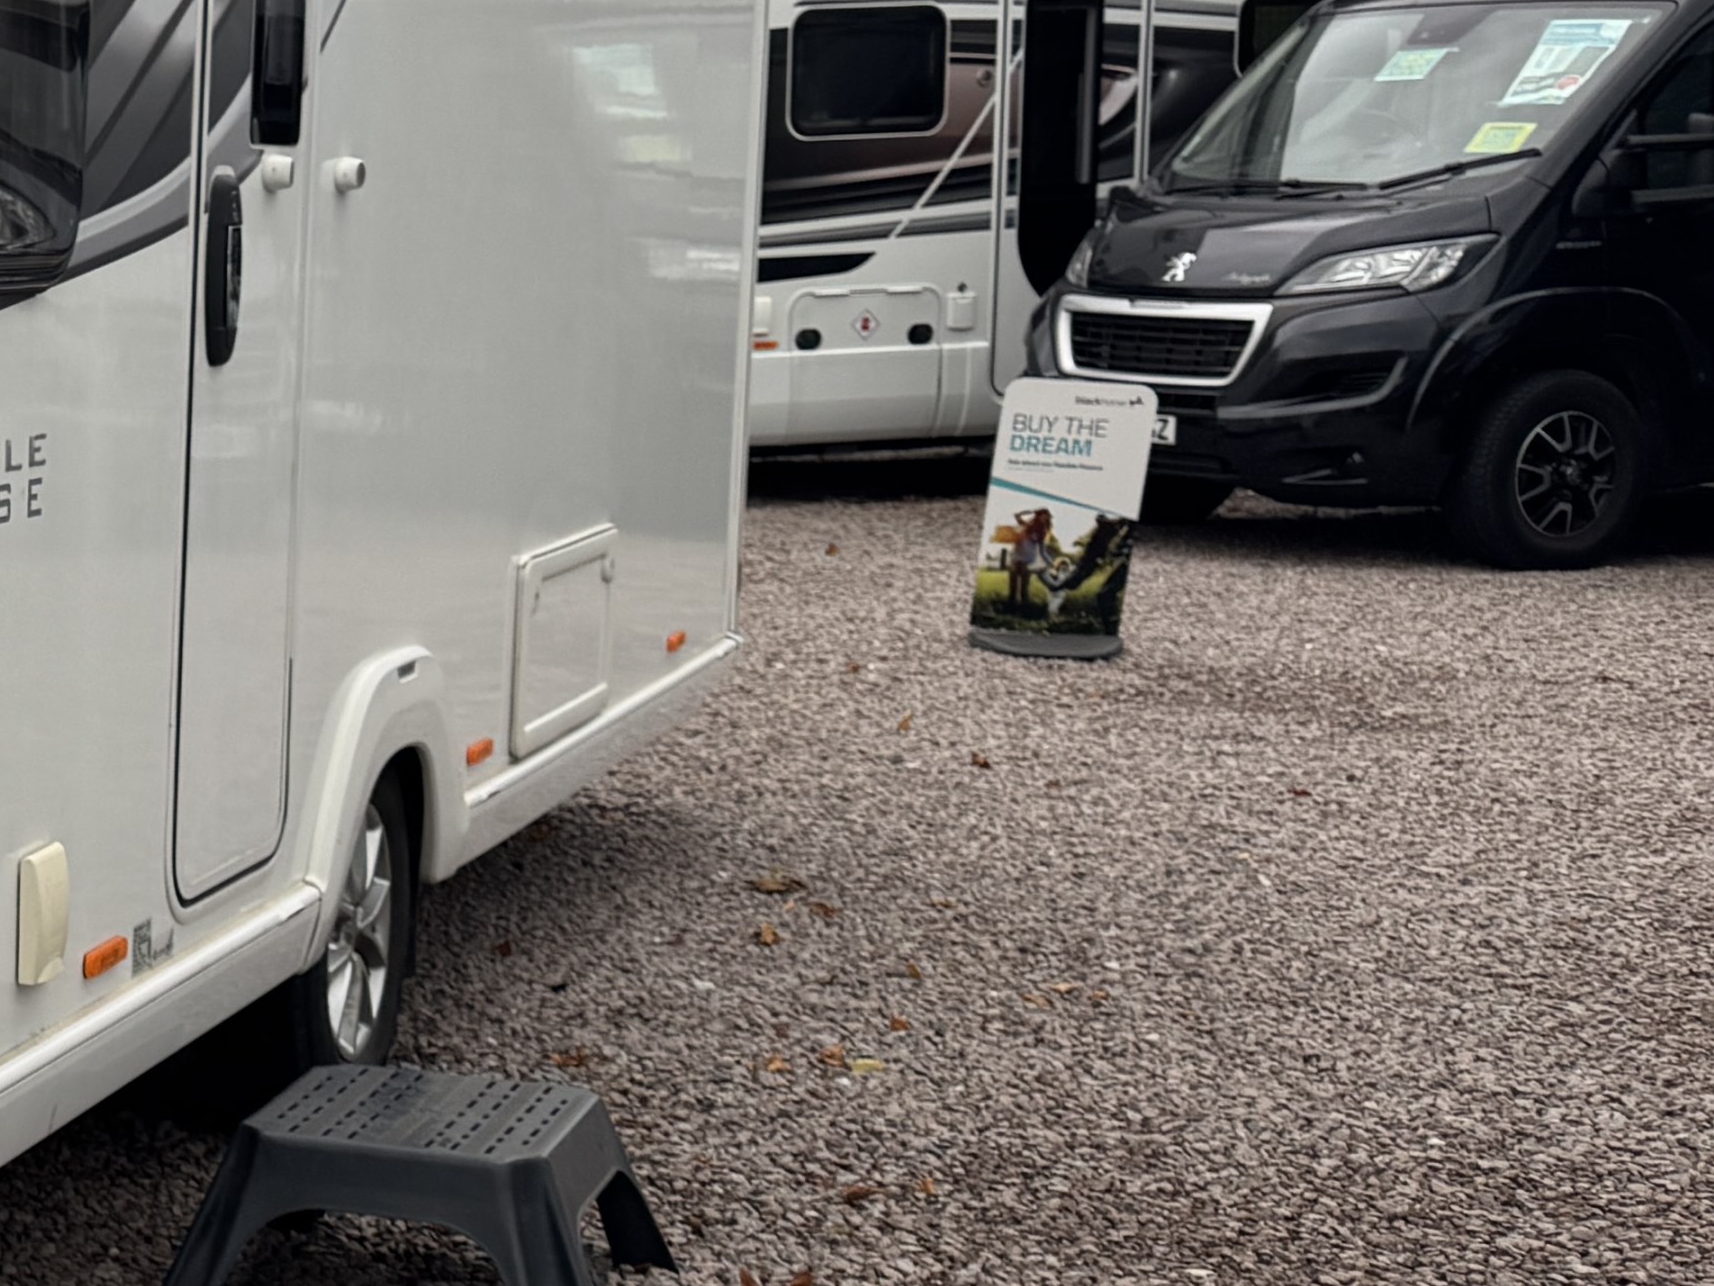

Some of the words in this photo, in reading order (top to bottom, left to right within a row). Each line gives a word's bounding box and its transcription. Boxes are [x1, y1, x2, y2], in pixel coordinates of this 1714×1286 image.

[1012, 413, 1059, 434] BUY
[1065, 417, 1110, 438] THE
[1010, 434, 1093, 457] DREAM
